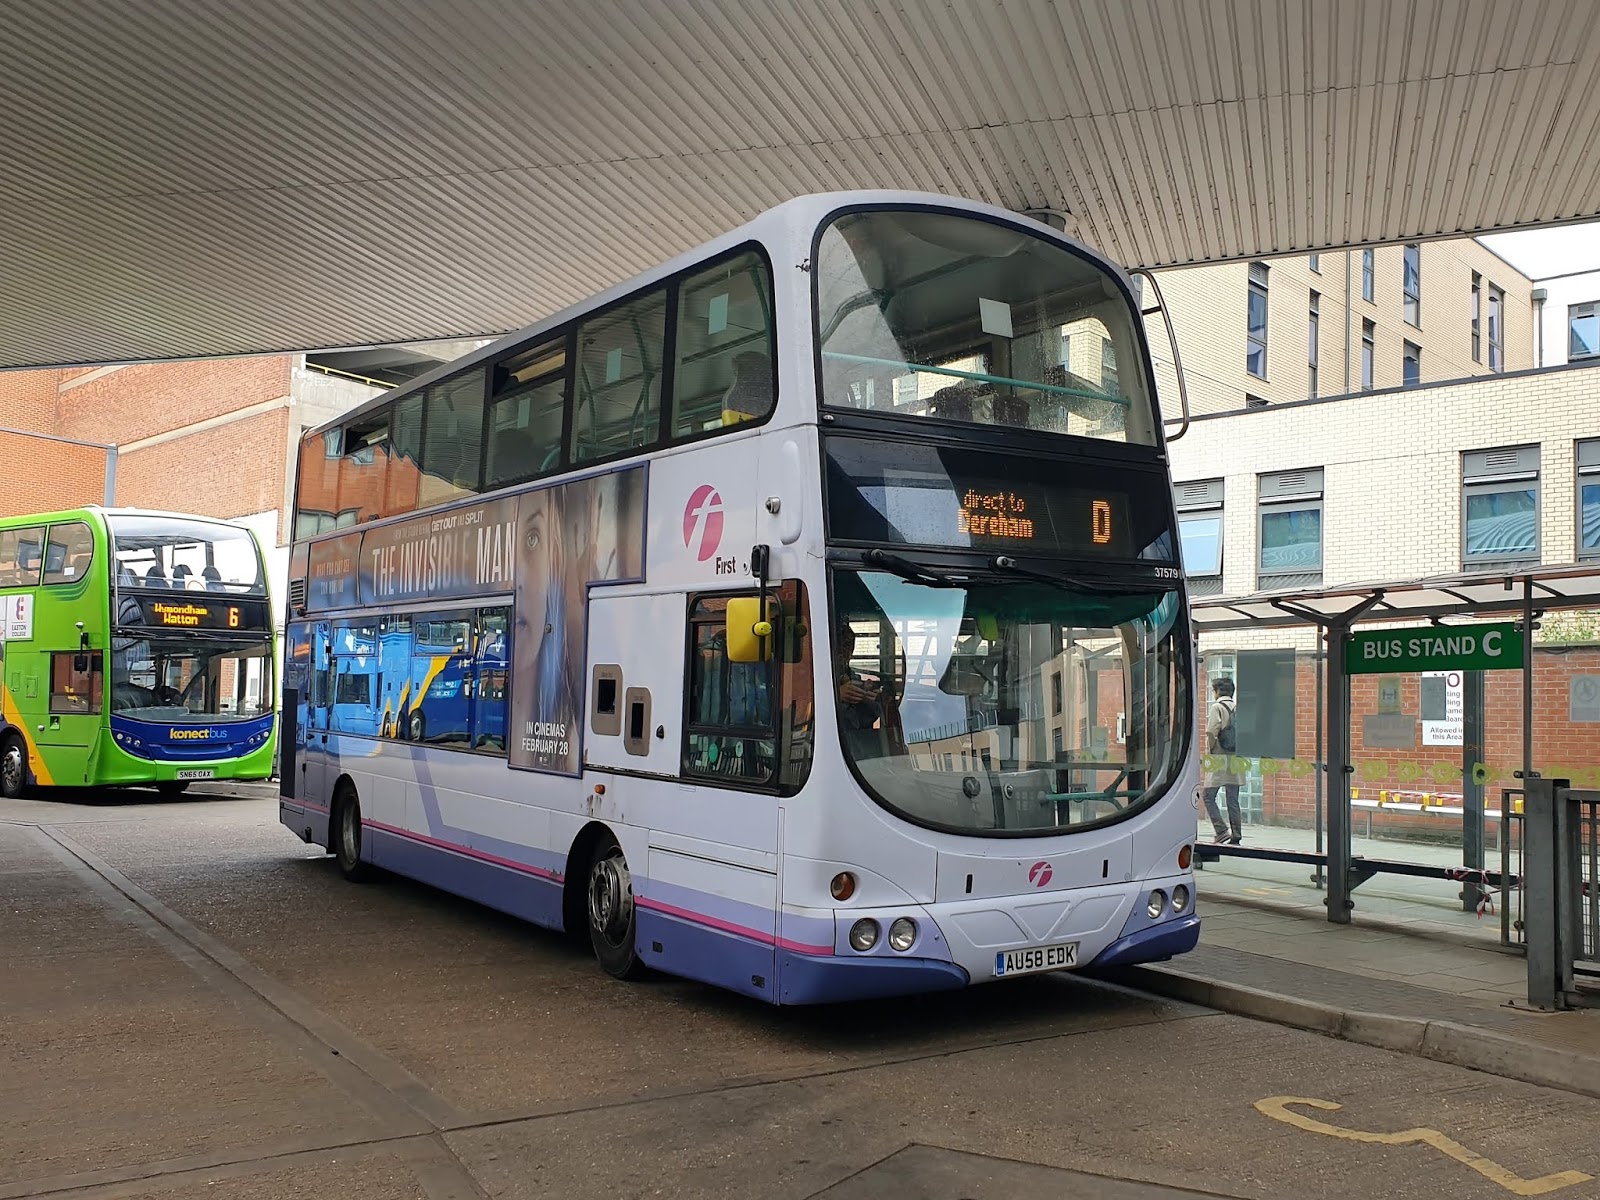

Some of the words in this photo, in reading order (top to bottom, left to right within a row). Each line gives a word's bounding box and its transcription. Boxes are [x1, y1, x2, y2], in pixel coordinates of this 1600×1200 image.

[964, 489, 1006, 511] direct
[1010, 492, 1025, 512] to
[431, 517, 444, 533] GET
[443, 515, 459, 531] OUT
[464, 509, 485, 525] SPLIT
[958, 508, 1033, 538] Dereham
[1093, 500, 1111, 544] D
[372, 545, 396, 597] THE
[400, 532, 471, 595] INVISIBLE
[476, 521, 517, 585] MAN
[716, 556, 737, 575] First
[1154, 566, 1179, 579] 37579
[154, 603, 208, 615] Wymondham
[163, 613, 199, 625] Watton
[229, 607, 239, 627] 6
[1363, 639, 1403, 659] BUS
[1408, 636, 1476, 657] STAND
[1482, 630, 1502, 657] C
[526, 721, 534, 735] IN
[534, 722, 566, 738] CINEMAS
[1430, 726, 1457, 734] Allowed
[522, 738, 559, 754] FEBRUARY
[559, 741, 569, 755] 28
[1006, 950, 1043, 972] AU58
[1047, 945, 1075, 966] EDK
